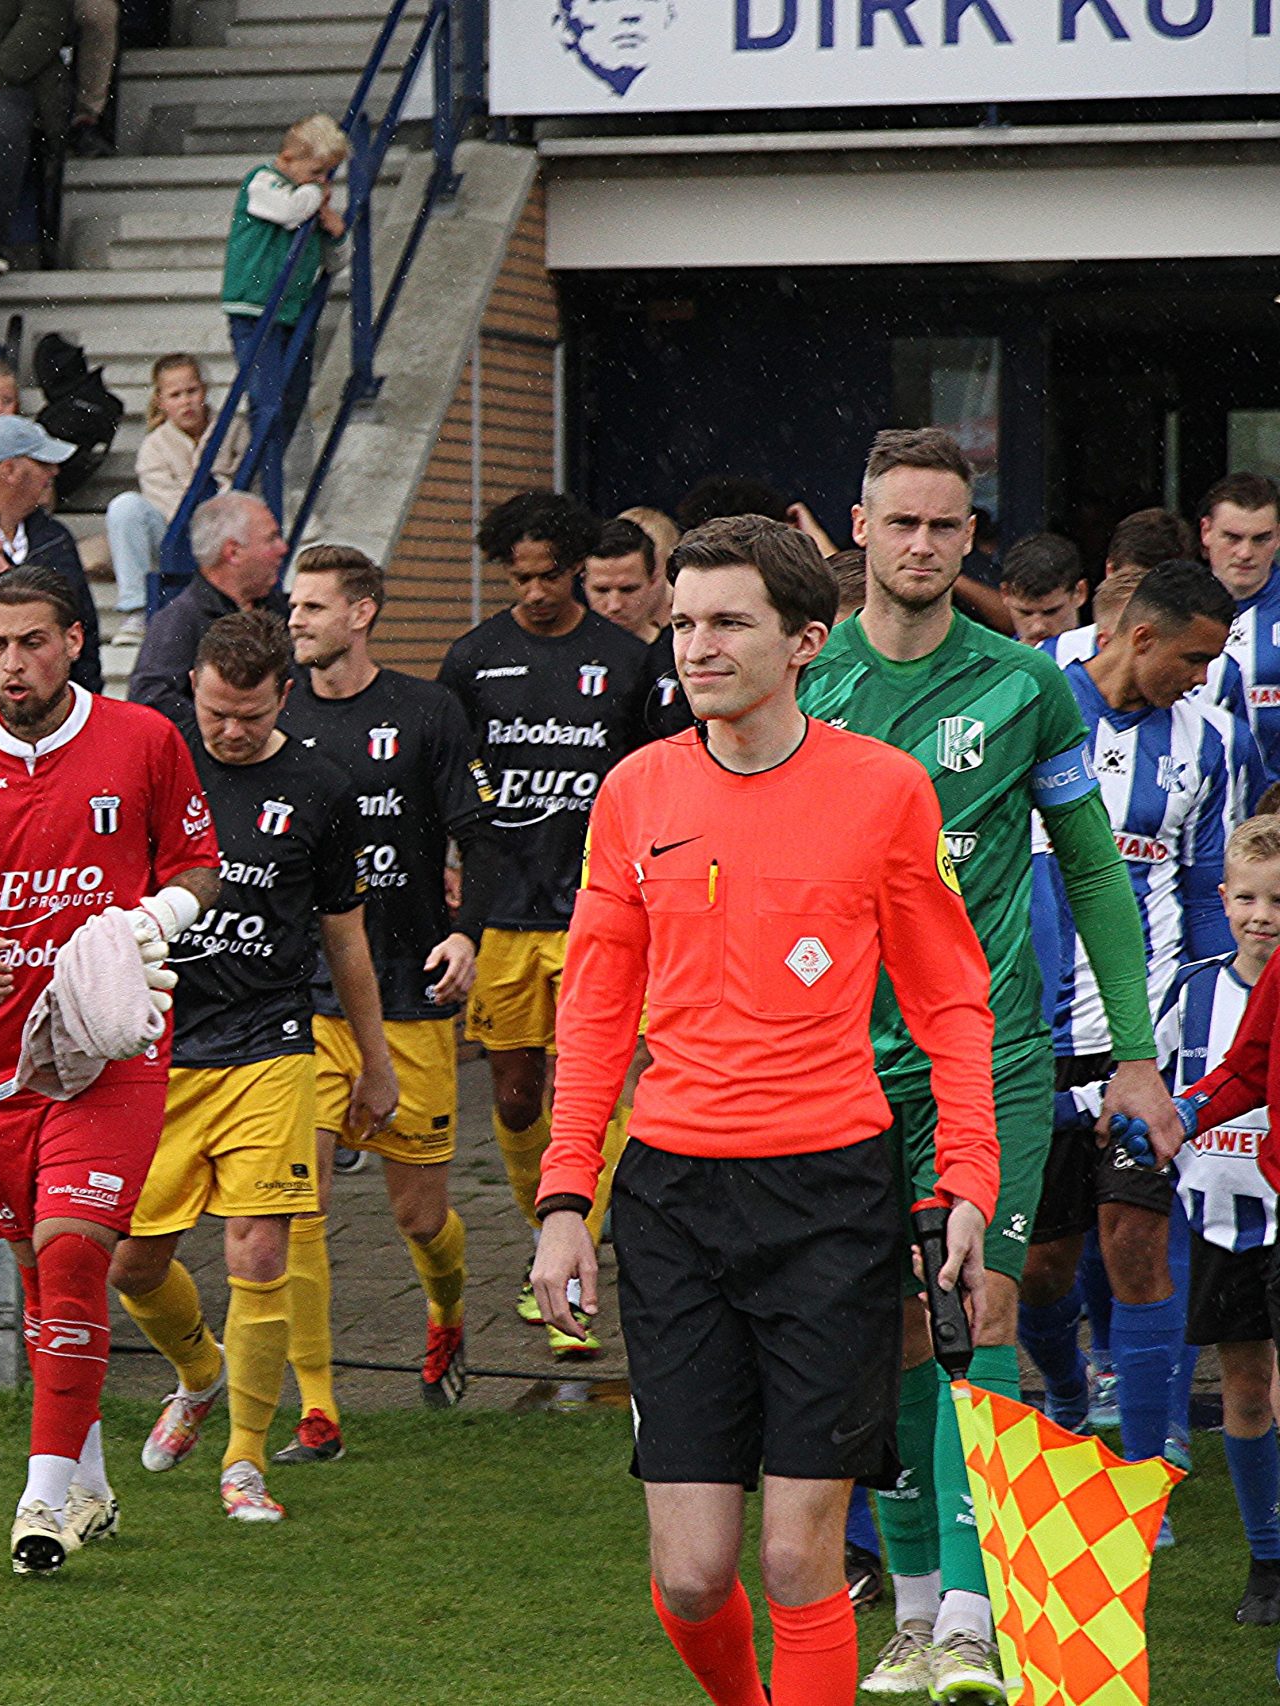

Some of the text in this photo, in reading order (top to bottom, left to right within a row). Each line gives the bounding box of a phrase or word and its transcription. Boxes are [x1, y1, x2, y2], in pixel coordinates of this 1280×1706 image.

[488, 717, 609, 748] Rabobank
[496, 769, 599, 808] Euro
[526, 795, 595, 811] PRODUC
[28, 891, 115, 909] PRODUCTS
[181, 932, 274, 957] PRODUCTS
